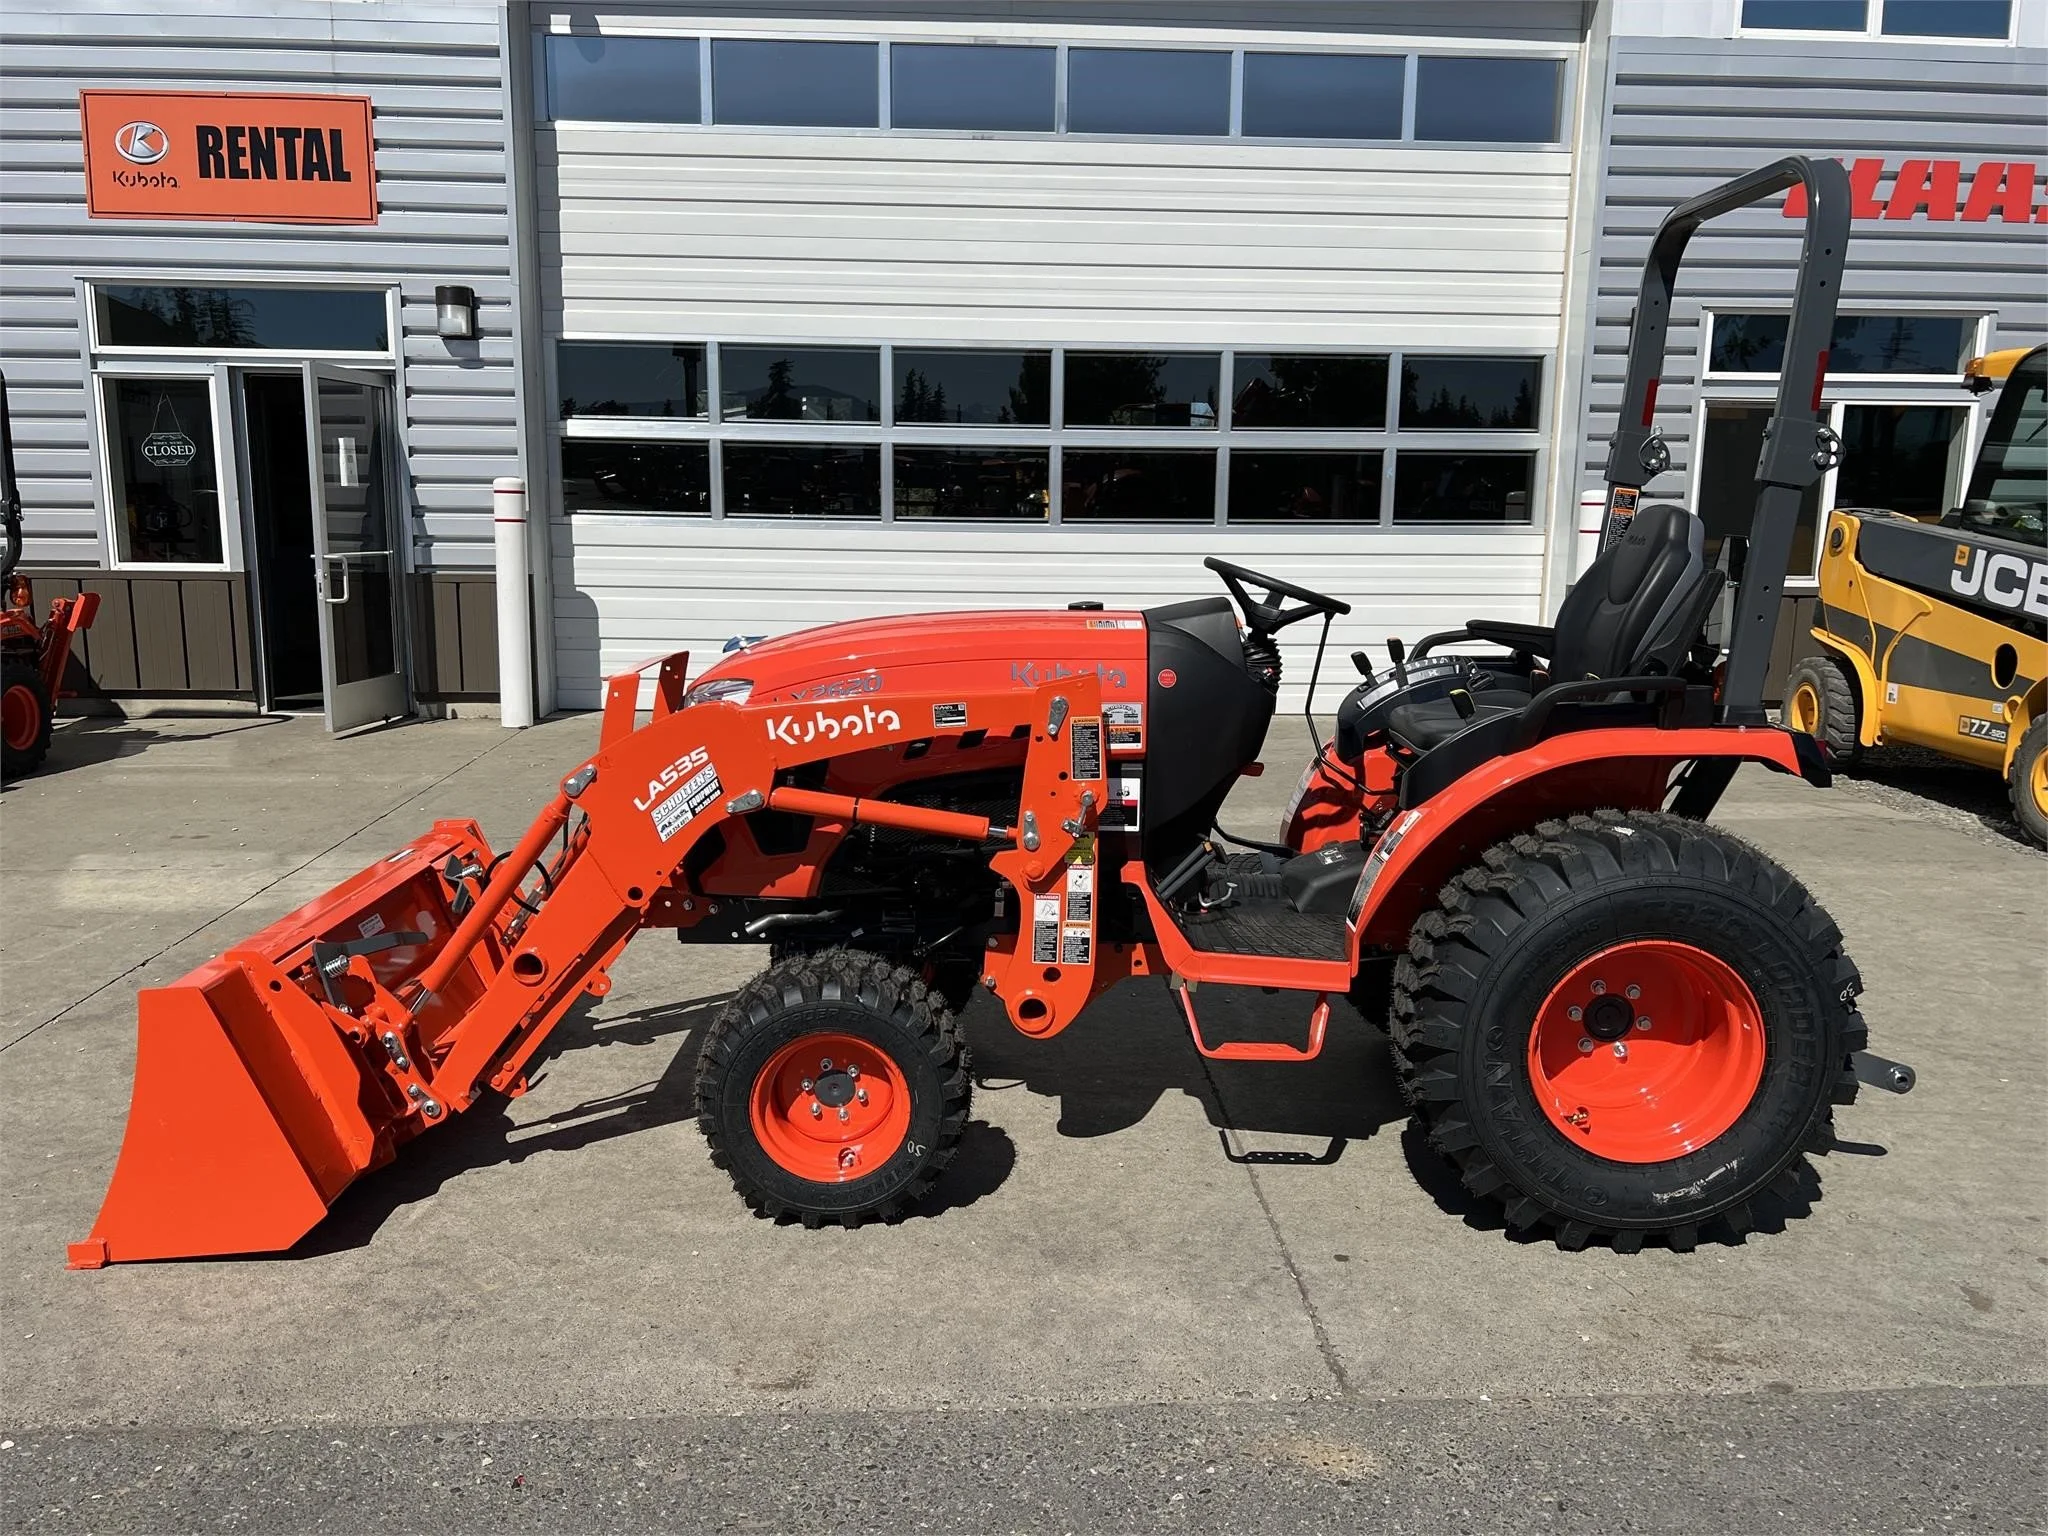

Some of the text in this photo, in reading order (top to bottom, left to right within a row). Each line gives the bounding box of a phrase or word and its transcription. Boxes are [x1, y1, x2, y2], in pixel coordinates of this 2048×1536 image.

[195, 124, 352, 182] RENTAL
[112, 170, 178, 189] Kubota
[1782, 157, 2048, 225] LAA
[144, 445, 194, 457] CLOSED
[1011, 662, 1127, 689] Kubta
[766, 704, 901, 745] Kubota
[633, 745, 709, 812] LA535
[652, 764, 714, 823] SCHOLTEN'S
[688, 777, 719, 809] EQUIPMENT
[1484, 1059, 1571, 1194] TITAN
